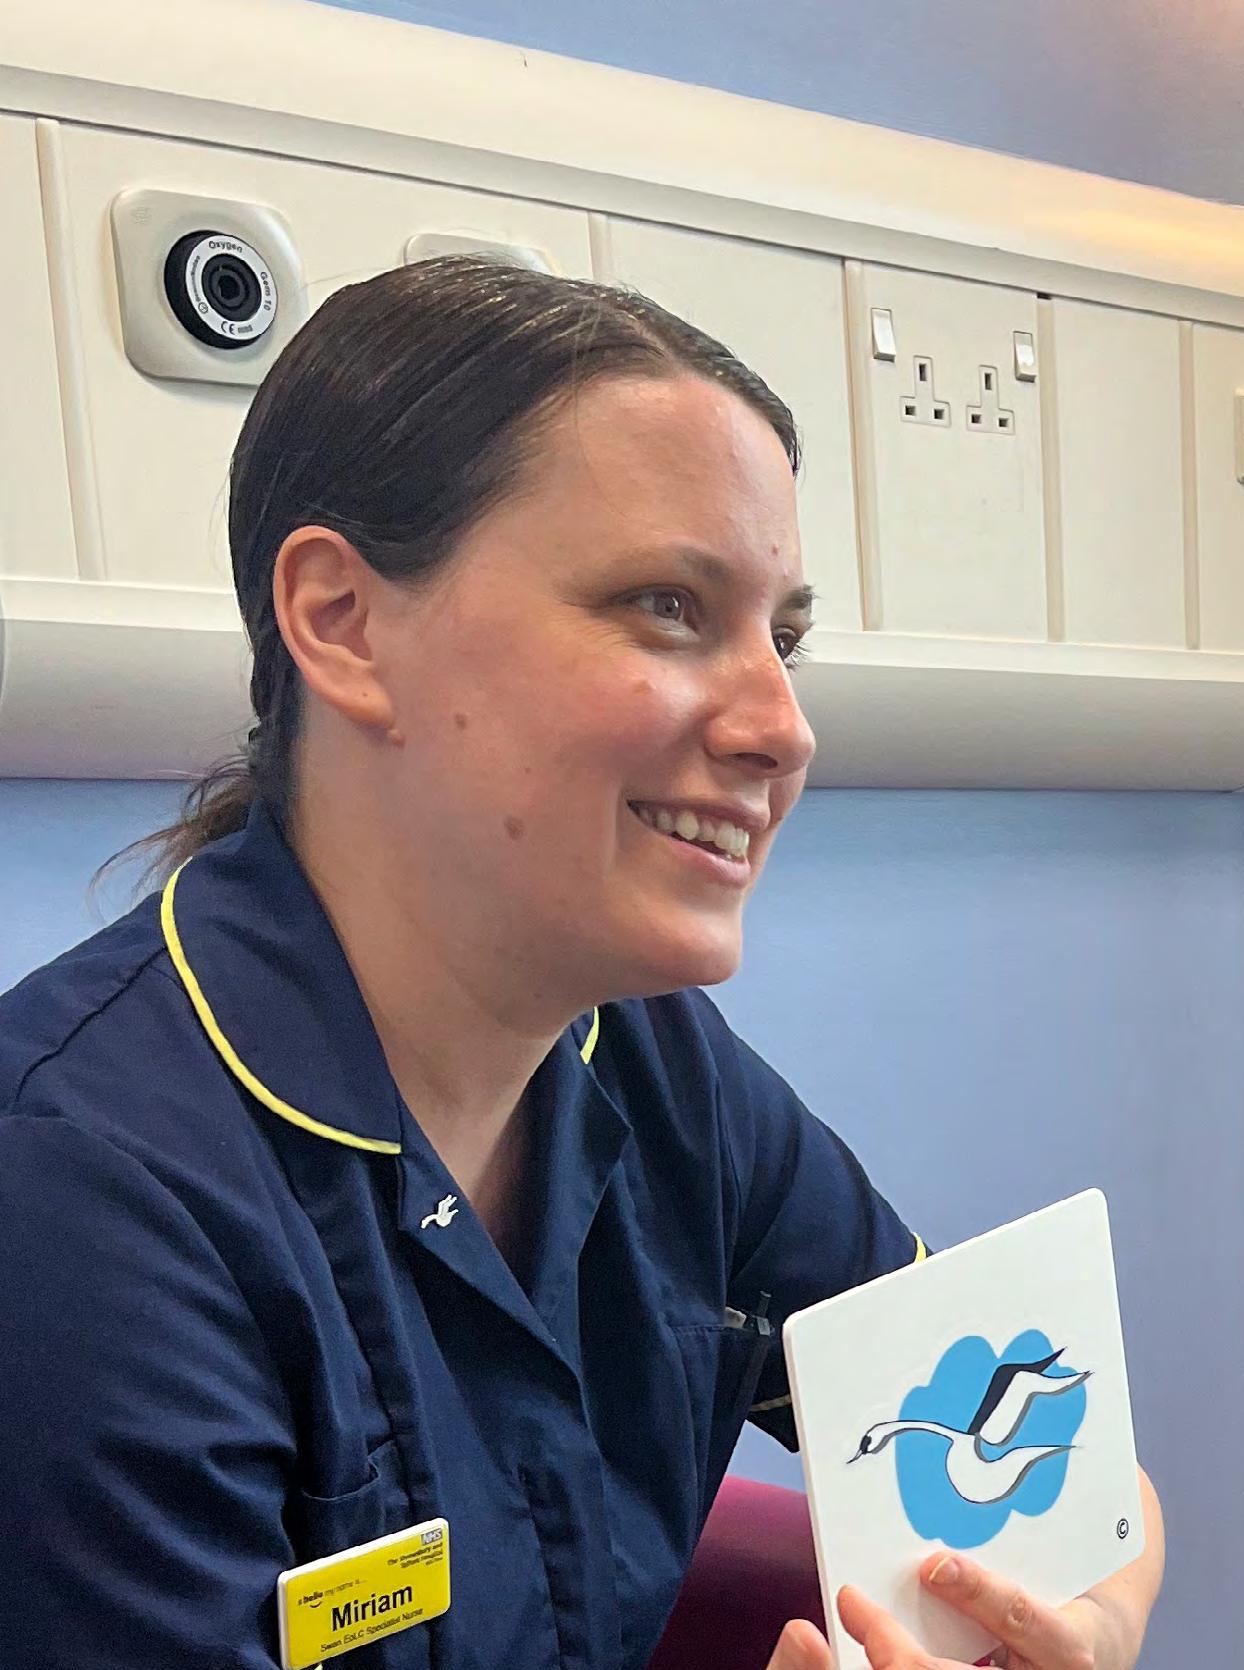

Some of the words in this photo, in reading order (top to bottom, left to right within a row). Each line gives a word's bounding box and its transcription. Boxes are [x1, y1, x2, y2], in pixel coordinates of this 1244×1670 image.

[208, 241, 243, 253] Oxygen
[320, 1636, 342, 1652] Swan
[401, 1605, 423, 1622] Nurse
[332, 1585, 412, 1632] Miriam
